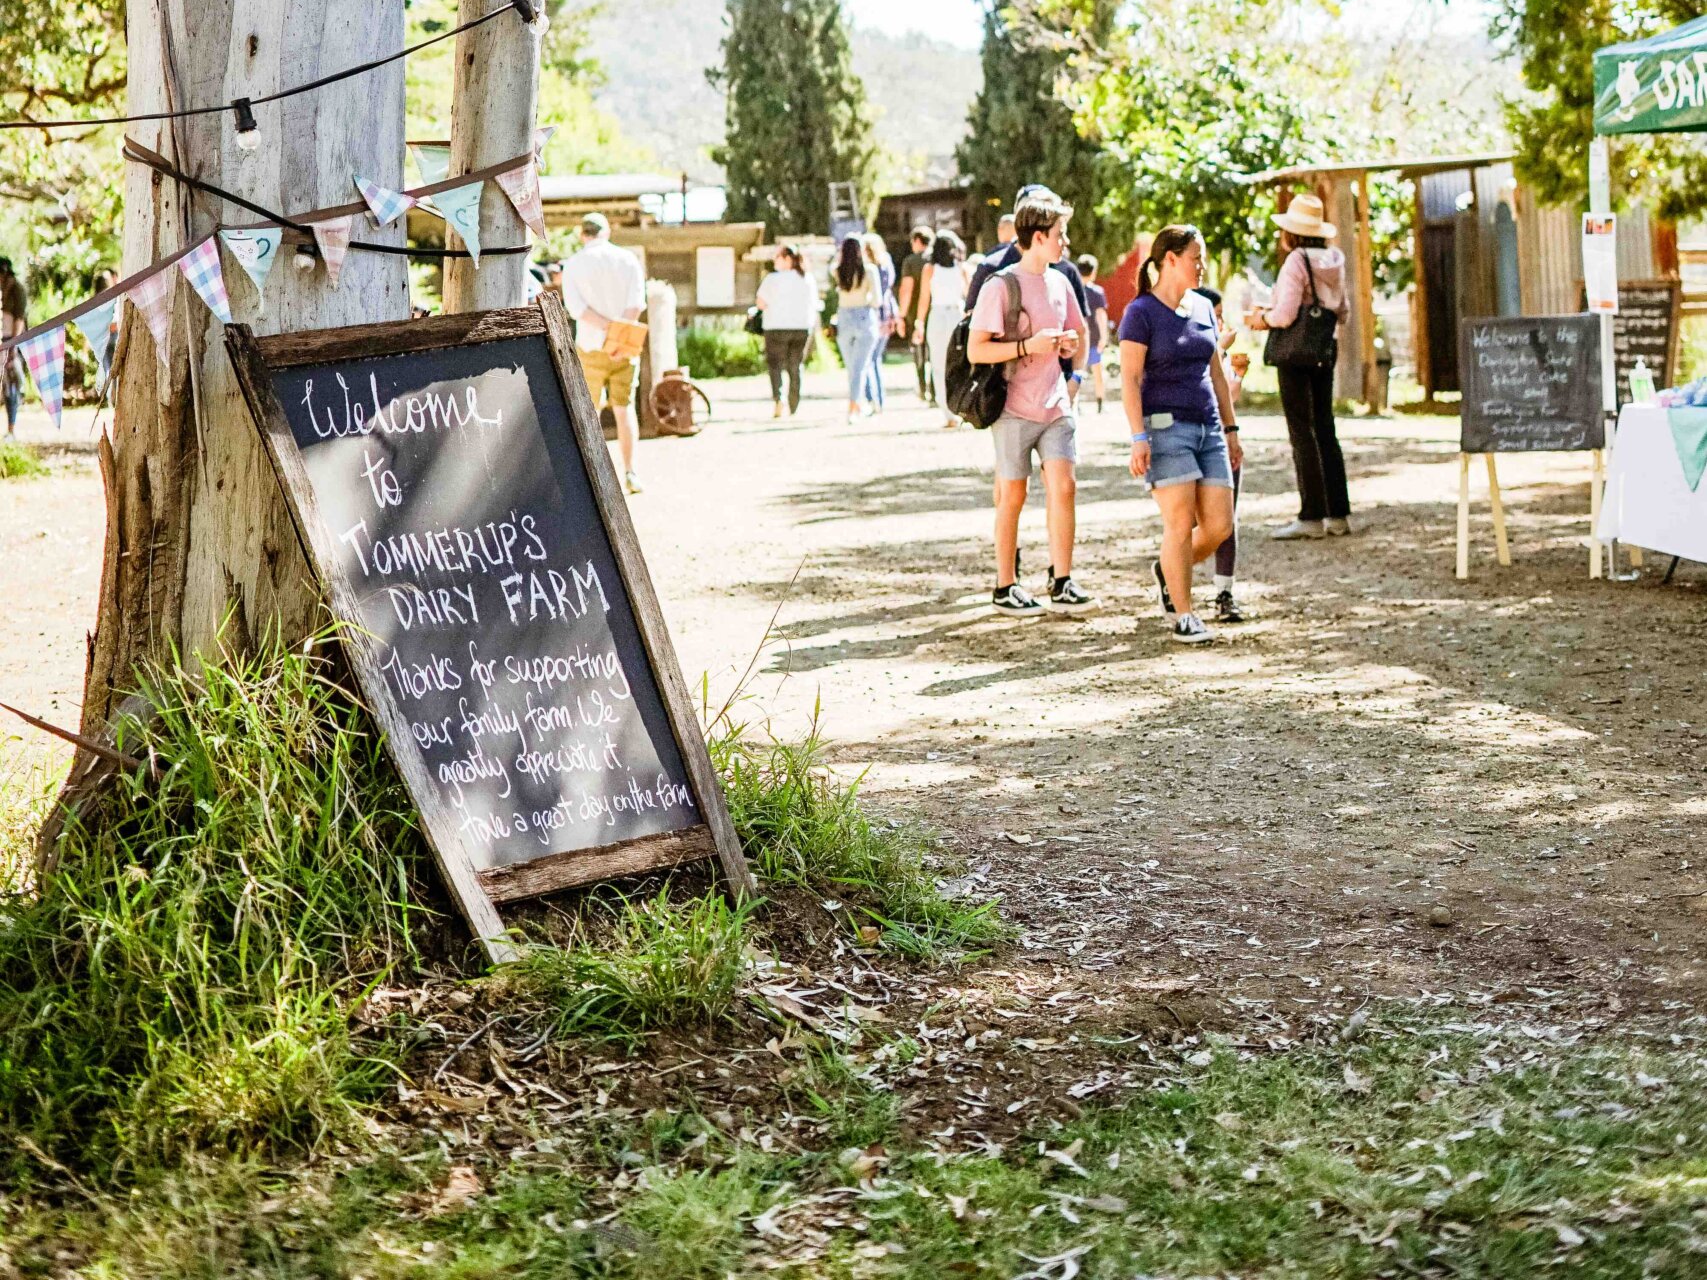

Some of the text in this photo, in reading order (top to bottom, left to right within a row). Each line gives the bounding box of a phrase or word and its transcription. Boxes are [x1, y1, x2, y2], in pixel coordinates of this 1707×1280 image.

[1473, 326, 1530, 348] Welcome
[301, 371, 503, 437] Welcome
[361, 450, 403, 509] to
[336, 509, 547, 577] TOMMERUP'S
[389, 559, 611, 631] DAIRY FARM
[382, 640, 631, 701] Thanks for supporting
[411, 717, 454, 749] our
[459, 697, 528, 756] family
[577, 690, 621, 727] We
[438, 743, 511, 807] greatly
[515, 739, 602, 785] appreciate
[512, 813, 528, 832] a
[532, 794, 574, 846] great
[579, 791, 616, 826] day
[655, 773, 694, 812] farm
